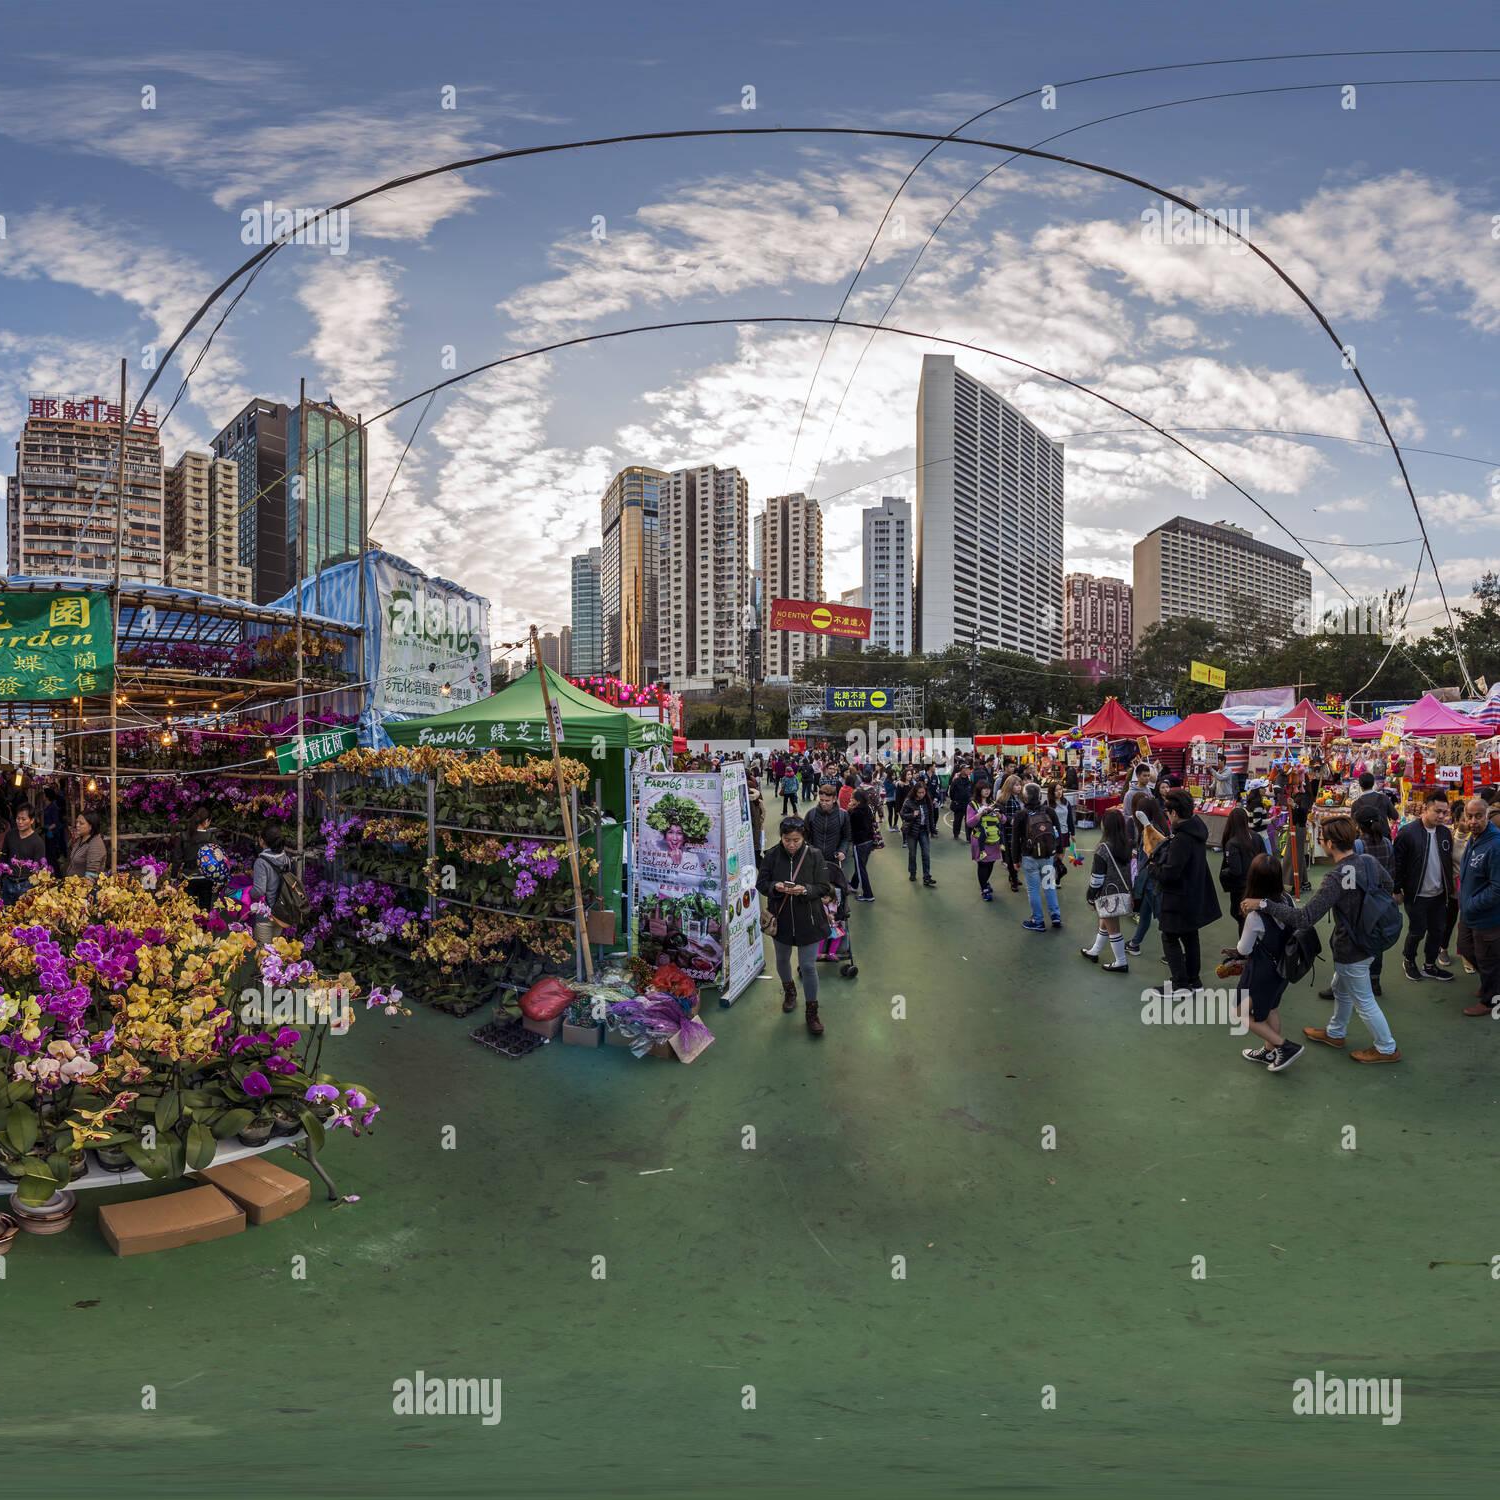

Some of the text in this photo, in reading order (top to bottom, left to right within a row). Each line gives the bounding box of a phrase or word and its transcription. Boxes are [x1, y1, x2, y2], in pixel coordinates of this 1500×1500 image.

[787, 611, 810, 620] ENTRY
[833, 691, 867, 700] 此路不通
[848, 700, 866, 708] EXIT
[1146, 709, 1158, 717] 出口
[418, 723, 476, 746] FARM66
[1442, 770, 1459, 778] hot
[643, 776, 682, 791] FARM66
[642, 856, 671, 868] Salad
[681, 861, 699, 871] Go!
